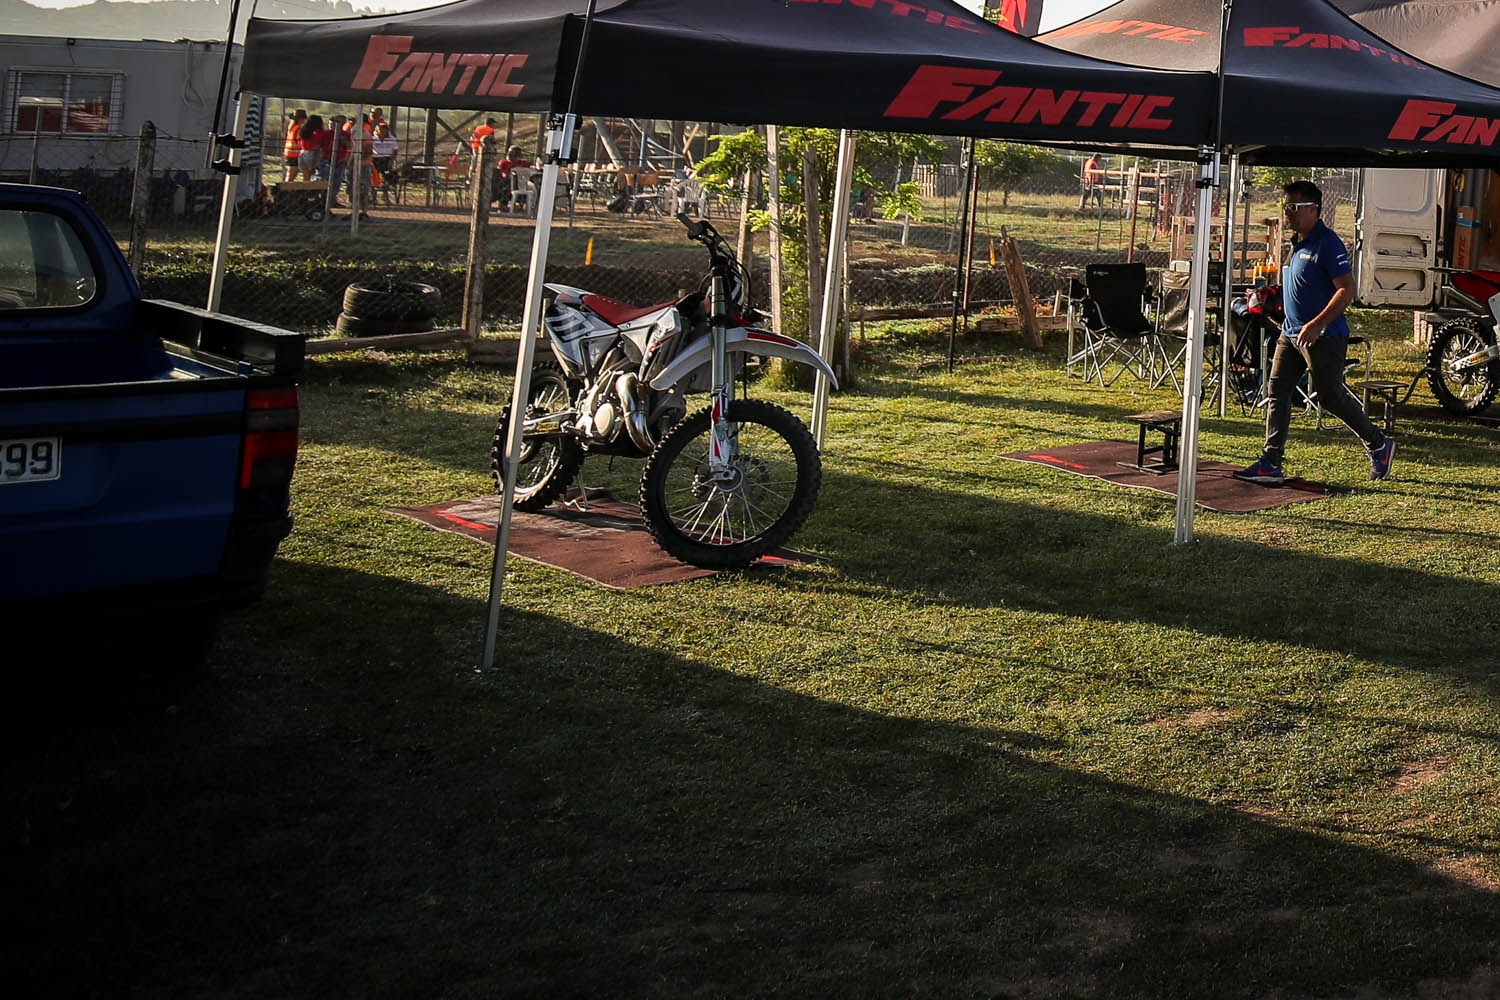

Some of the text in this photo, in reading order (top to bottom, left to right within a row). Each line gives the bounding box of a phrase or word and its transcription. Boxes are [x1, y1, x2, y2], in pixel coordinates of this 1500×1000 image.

[351, 34, 528, 97] FANTIC
[883, 65, 1175, 130] FANTIC
[0, 441, 53, 477] 99
